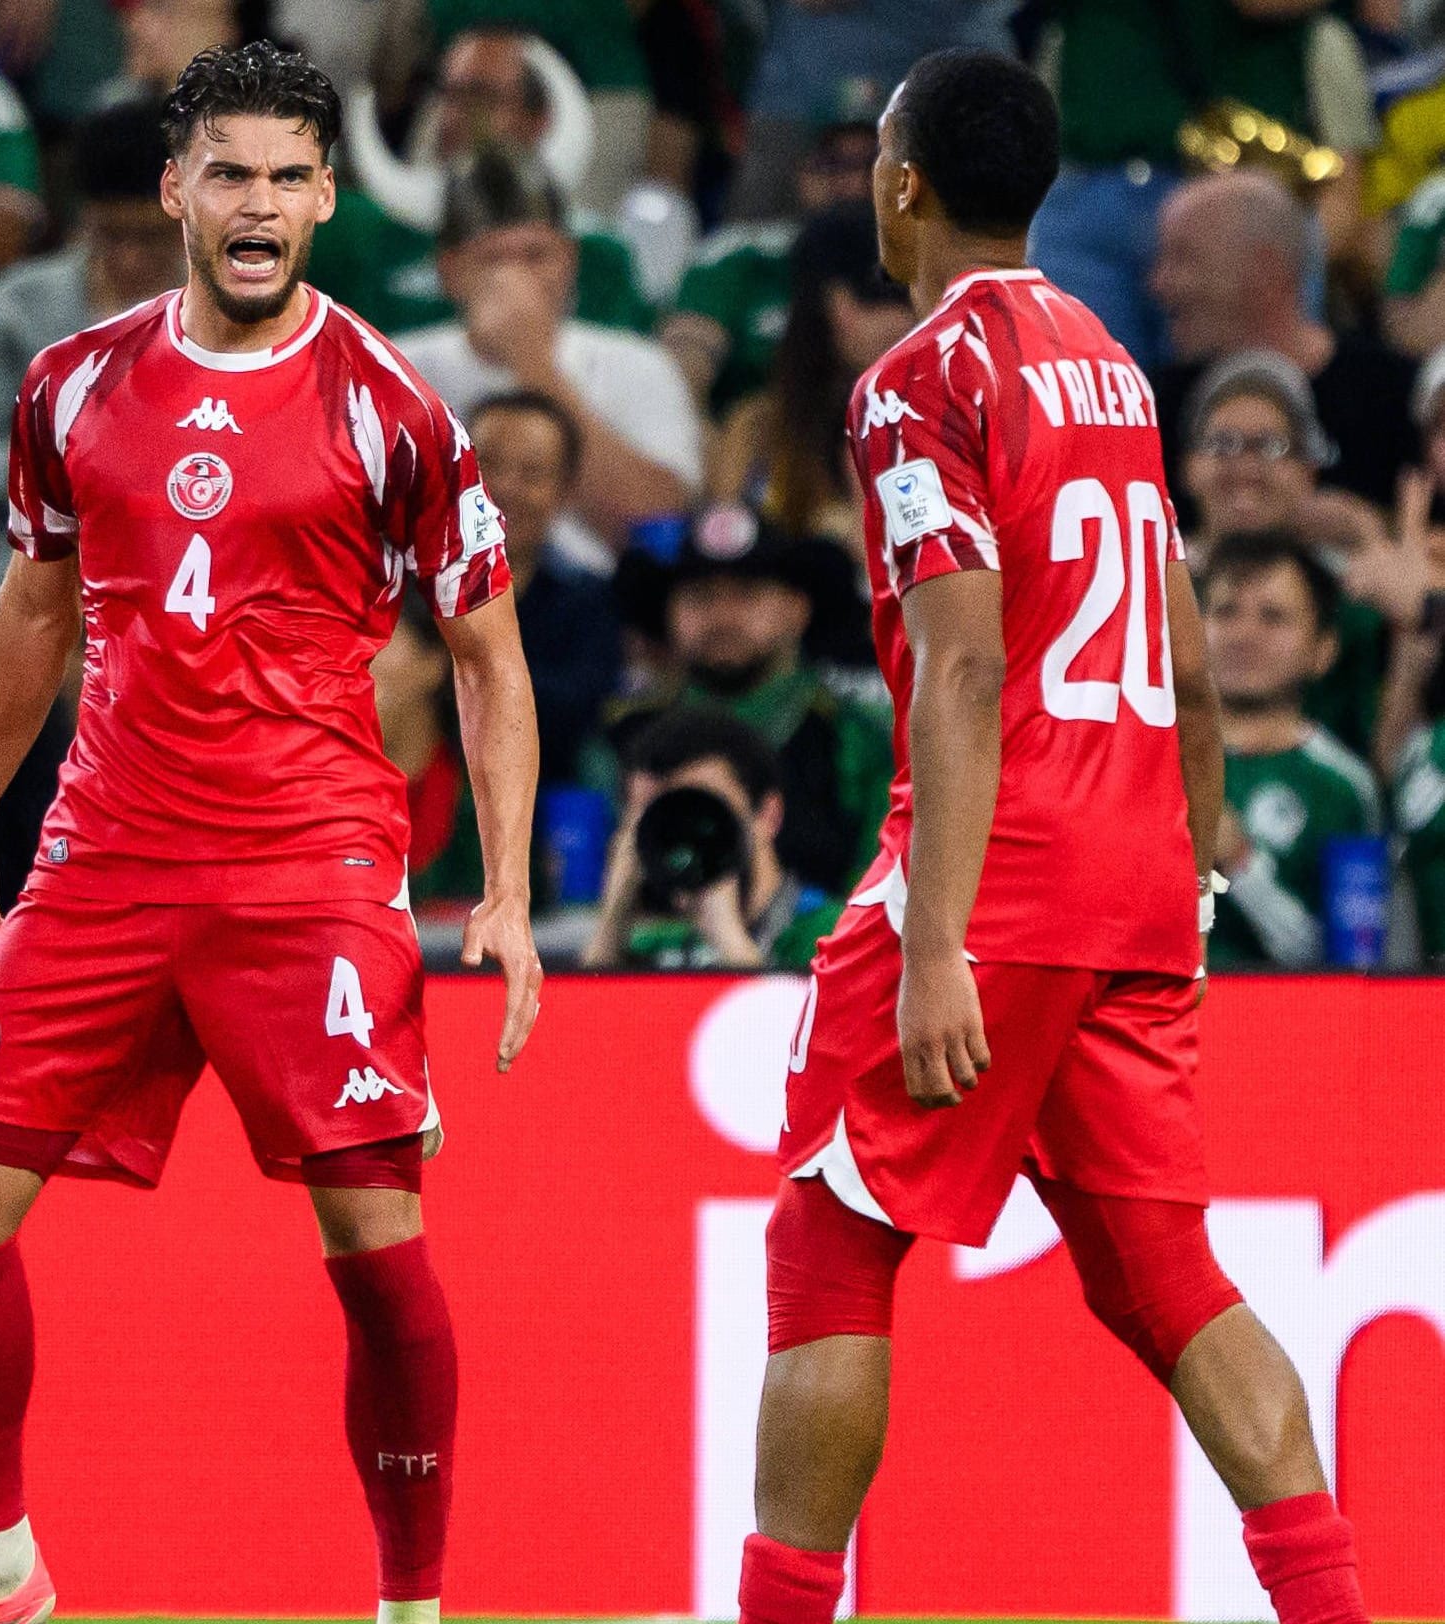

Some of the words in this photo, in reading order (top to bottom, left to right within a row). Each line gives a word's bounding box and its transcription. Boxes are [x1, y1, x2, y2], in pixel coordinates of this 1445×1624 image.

[1019, 358, 1158, 428] VALERY
[164, 532, 217, 632] 4
[1040, 476, 1177, 728] 20
[325, 955, 375, 1049] 4
[378, 1451, 437, 1477] FTF
